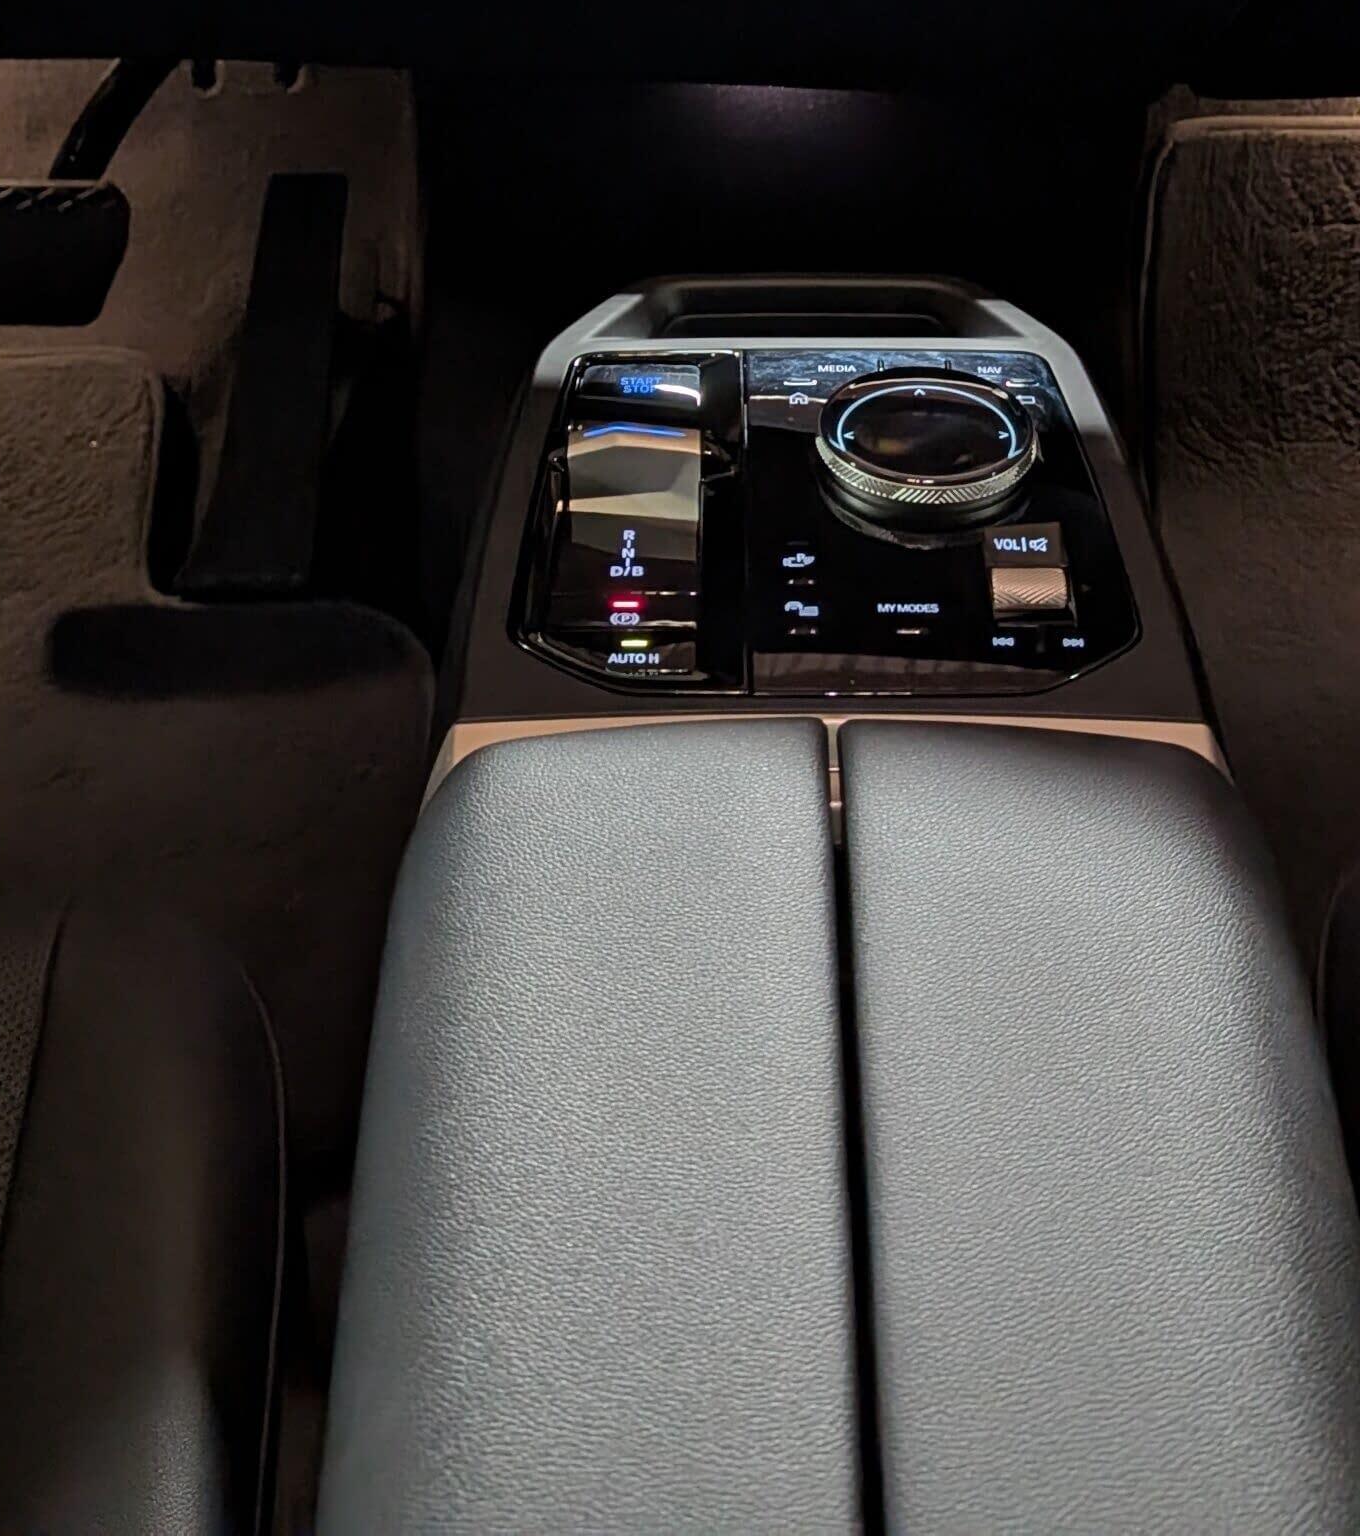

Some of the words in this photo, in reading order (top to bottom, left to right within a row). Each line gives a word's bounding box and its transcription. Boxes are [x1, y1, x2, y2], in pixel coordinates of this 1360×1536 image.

[818, 365, 857, 374] MEDIA
[977, 366, 1002, 375] NAV
[620, 376, 662, 386] START
[623, 529, 636, 541] R
[993, 538, 1021, 551] VOL
[621, 548, 636, 559] N
[609, 565, 645, 577] D/B
[876, 602, 896, 614] MY
[897, 602, 940, 615] MODES
[607, 652, 647, 665] AUTO
[648, 652, 660, 664] H
